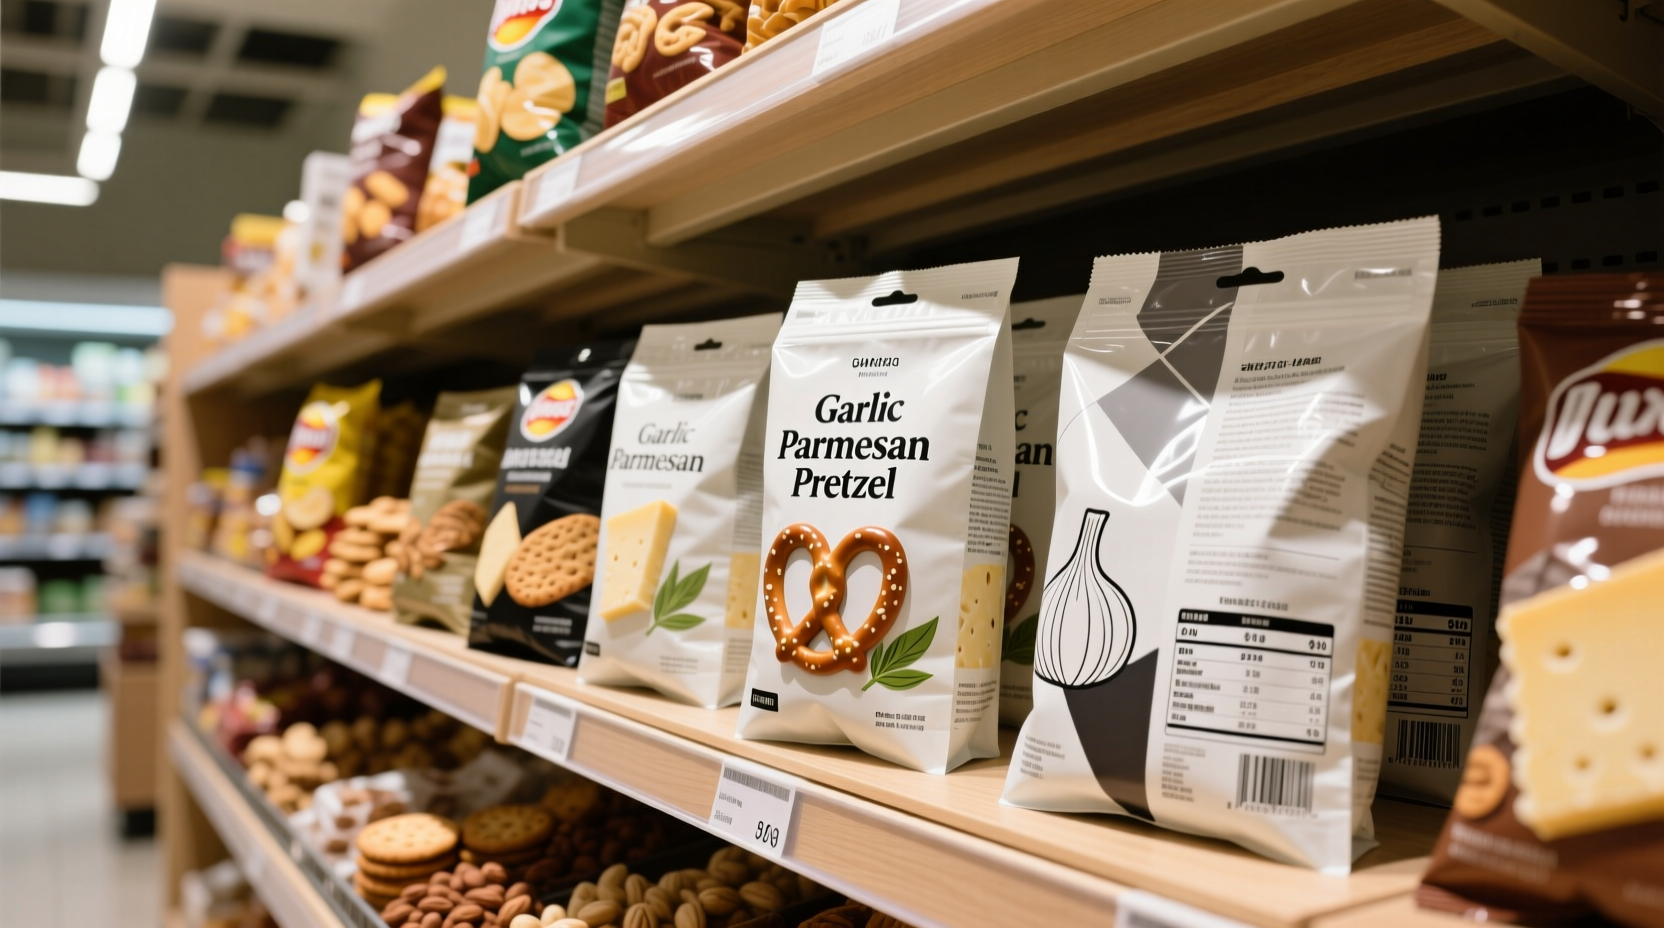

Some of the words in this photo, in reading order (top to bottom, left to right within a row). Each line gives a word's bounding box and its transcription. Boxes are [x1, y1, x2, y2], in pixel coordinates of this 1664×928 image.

[815, 391, 905, 423] Garlic
[637, 421, 696, 445] Garlic
[777, 430, 930, 461] Parmesan
[610, 448, 705, 473] Parmesan
[791, 466, 897, 499] Pretzel
